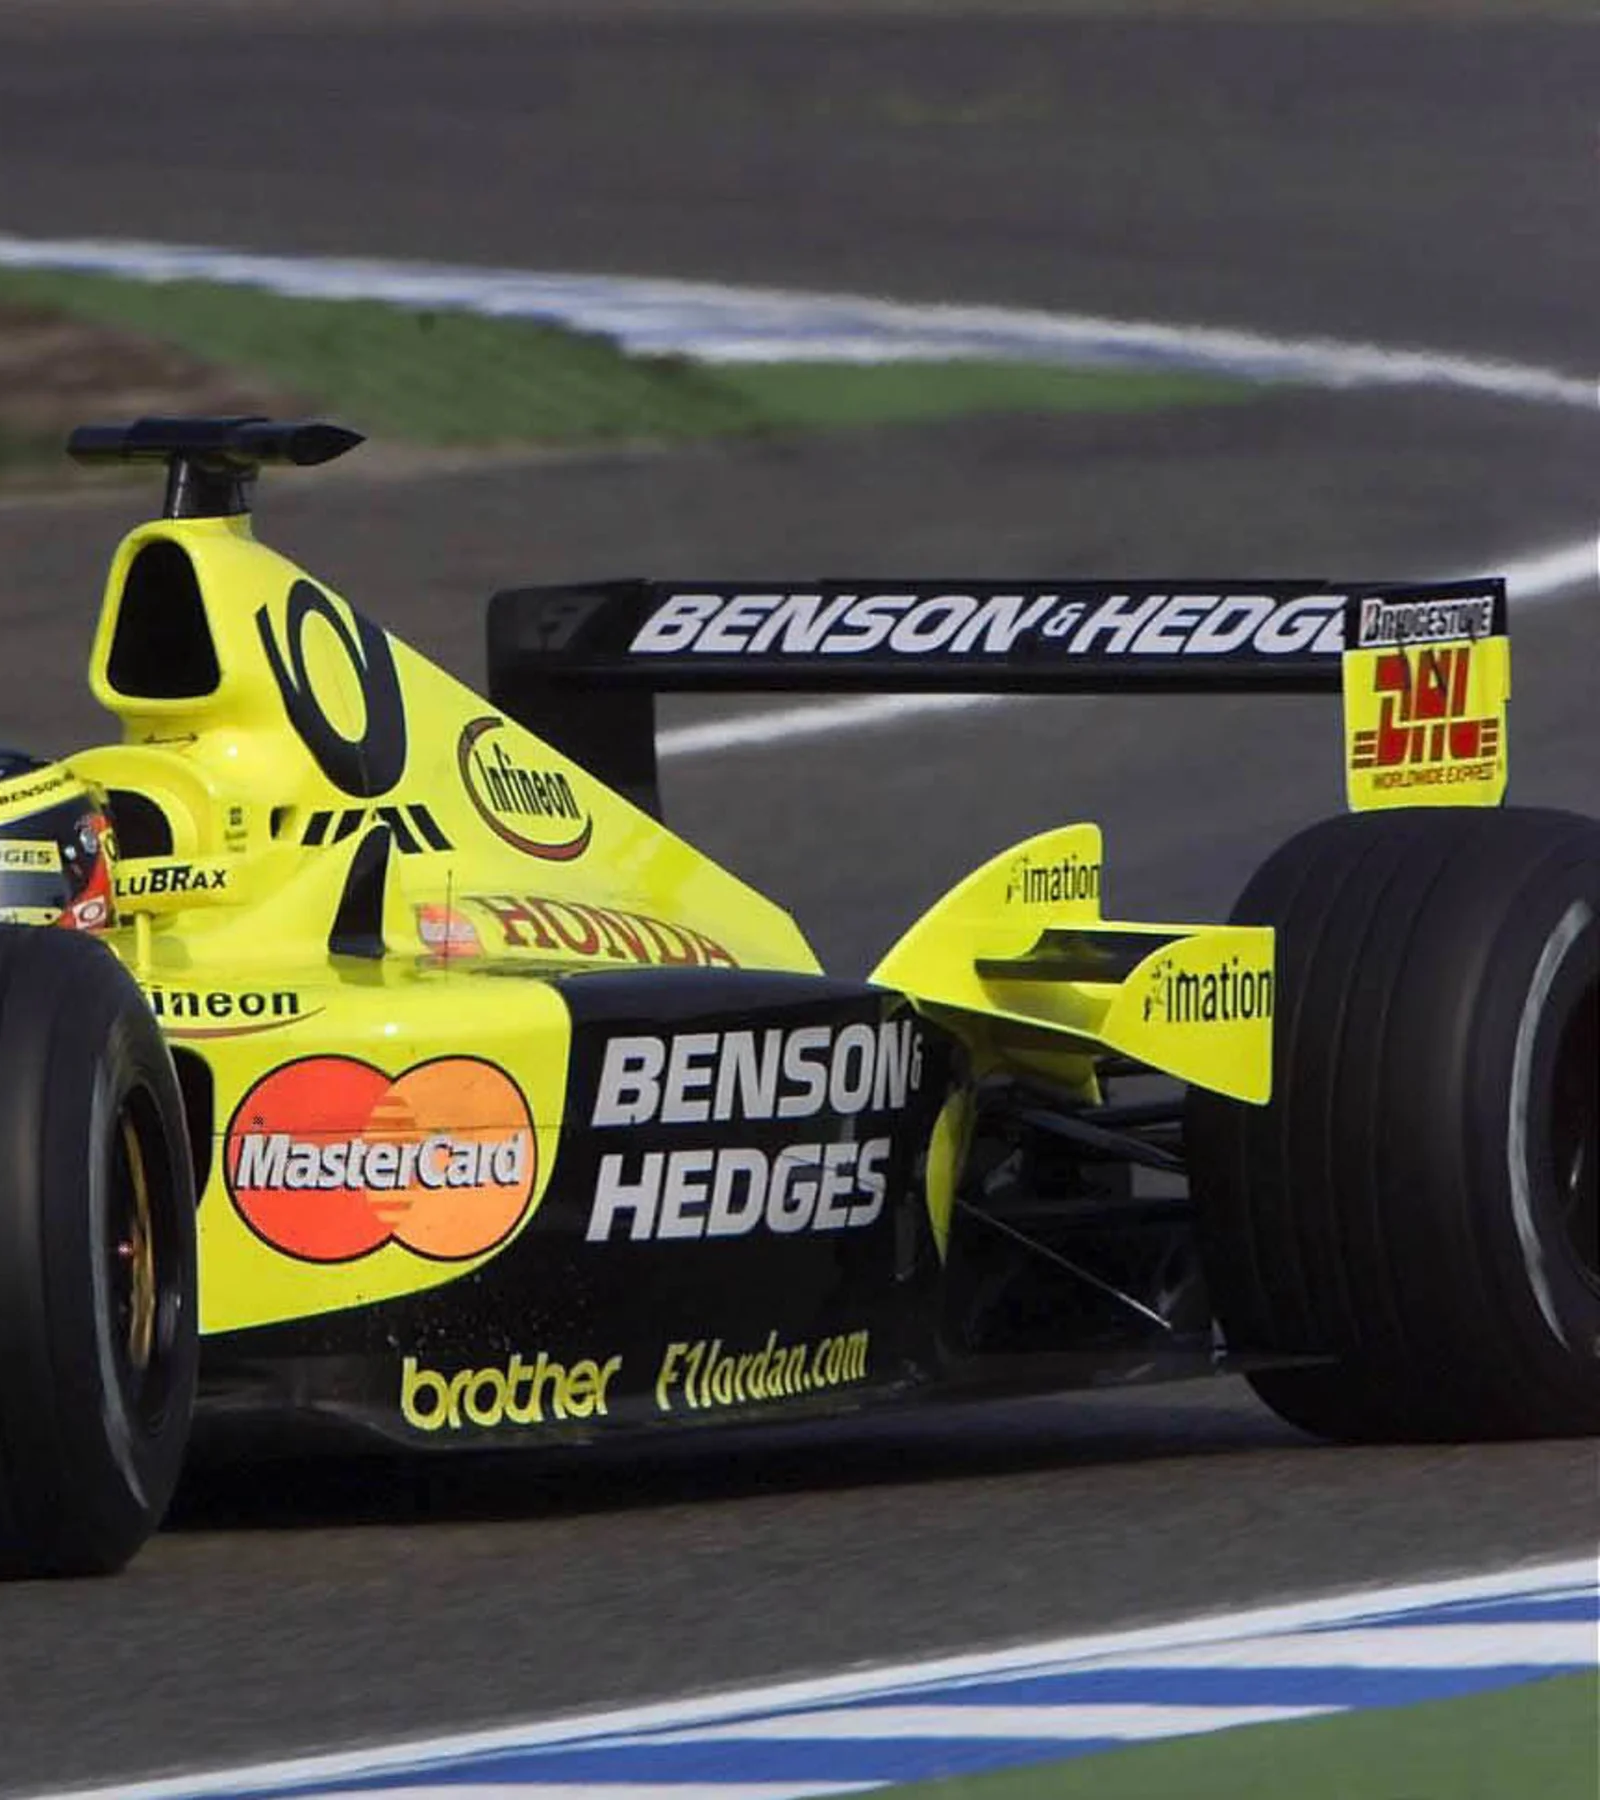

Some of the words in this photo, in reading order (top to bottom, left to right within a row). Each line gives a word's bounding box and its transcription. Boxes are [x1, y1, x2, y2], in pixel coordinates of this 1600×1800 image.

[628, 594, 1057, 653] BENSON
[1042, 603, 1087, 637] &
[473, 742, 582, 820] Infineon
[1022, 854, 1099, 903] imation
[458, 896, 742, 968] HONDA
[1167, 957, 1273, 1022] imation
[590, 1019, 913, 1127] BENSON
[235, 1127, 525, 1190] MasterCard
[584, 1137, 892, 1242] HEDGES
[402, 1351, 623, 1431] brother
